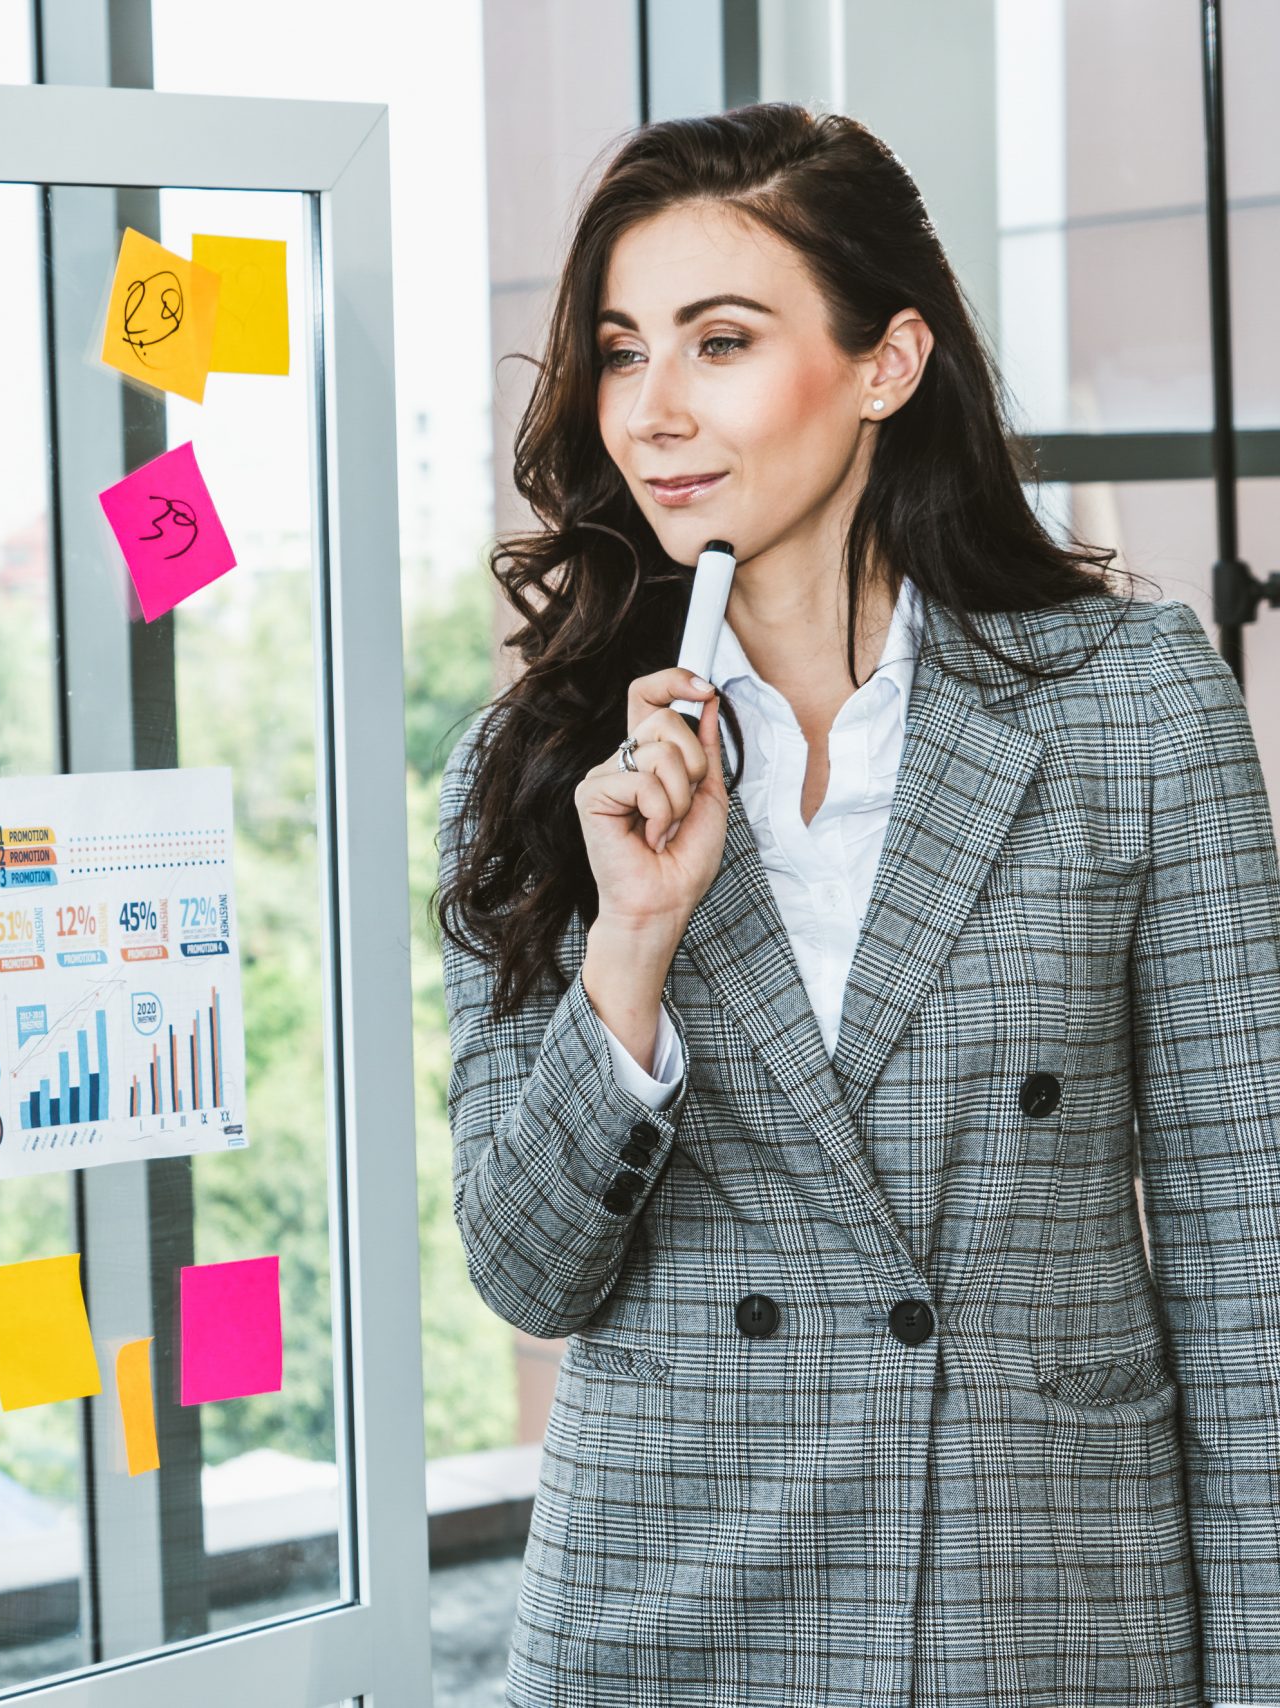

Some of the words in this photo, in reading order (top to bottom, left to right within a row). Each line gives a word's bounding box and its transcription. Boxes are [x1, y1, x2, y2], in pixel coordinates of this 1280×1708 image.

[8, 829, 49, 842] PROMOTION
[0, 846, 6, 866] 2
[9, 849, 50, 863] PROMOTION
[0, 867, 7, 887] 3
[11, 870, 51, 884] PROMOTION
[56, 904, 97, 937] 12%
[119, 900, 157, 932] 45%
[159, 898, 169, 943] INVESTMENT
[179, 896, 217, 928] 72%
[219, 894, 229, 938] INVESTMENT
[34, 907, 46, 952] INVESTMENT
[186, 943, 217, 955] PROMOTION
[137, 1001, 157, 1016] 2020
